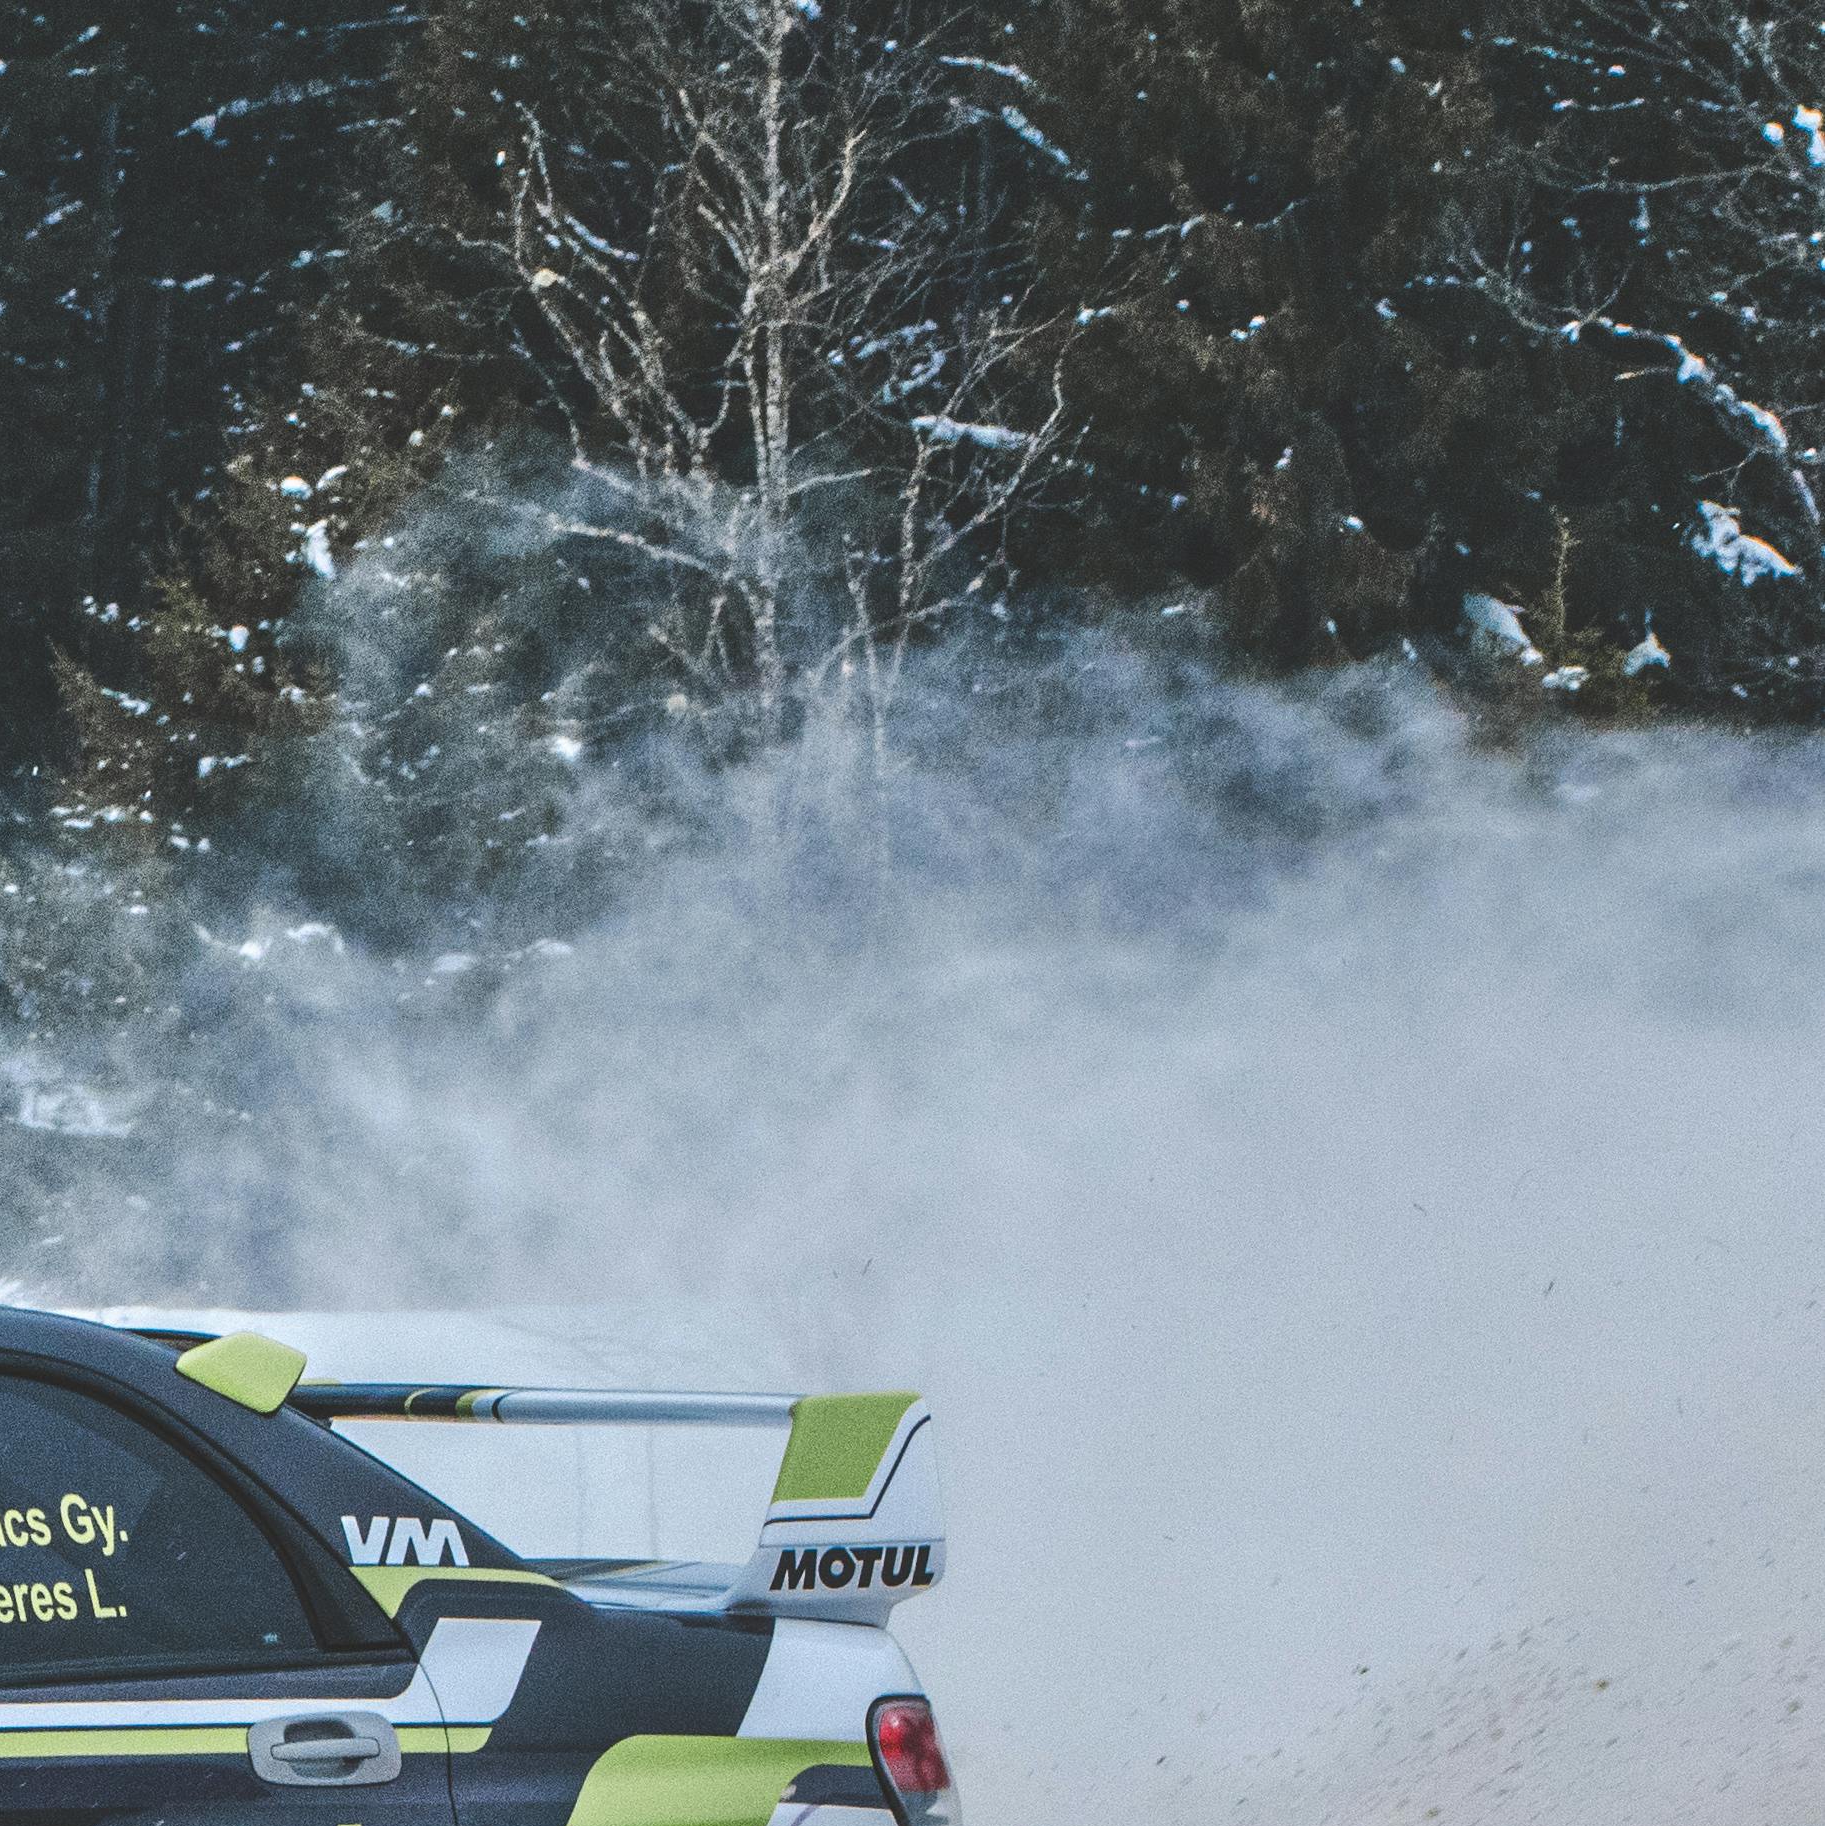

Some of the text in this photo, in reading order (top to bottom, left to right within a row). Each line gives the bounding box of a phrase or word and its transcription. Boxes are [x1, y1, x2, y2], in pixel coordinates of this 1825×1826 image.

[60, 1493, 129, 1556] Gy.
[340, 1515, 470, 1567] VM
[84, 1567, 128, 1619] L.
[769, 1543, 936, 1591] MOTUL
